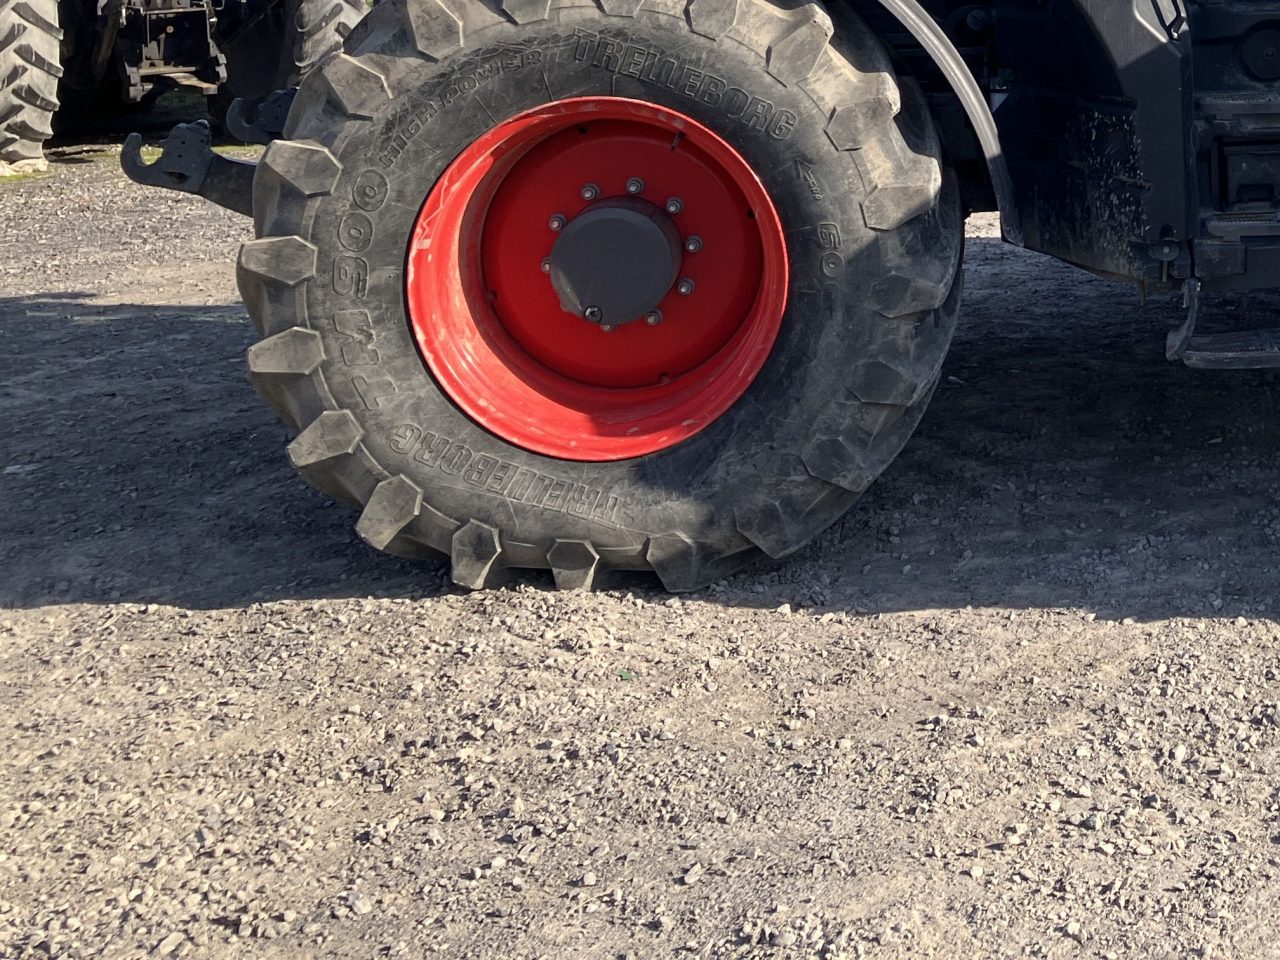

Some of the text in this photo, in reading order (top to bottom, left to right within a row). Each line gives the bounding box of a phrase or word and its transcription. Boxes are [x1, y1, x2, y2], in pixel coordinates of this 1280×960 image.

[378, 101, 440, 168] HIGH
[438, 49, 543, 107] POWER
[573, 26, 797, 140] TRELLEBORG
[390, 423, 619, 530] TRELLEBORG
